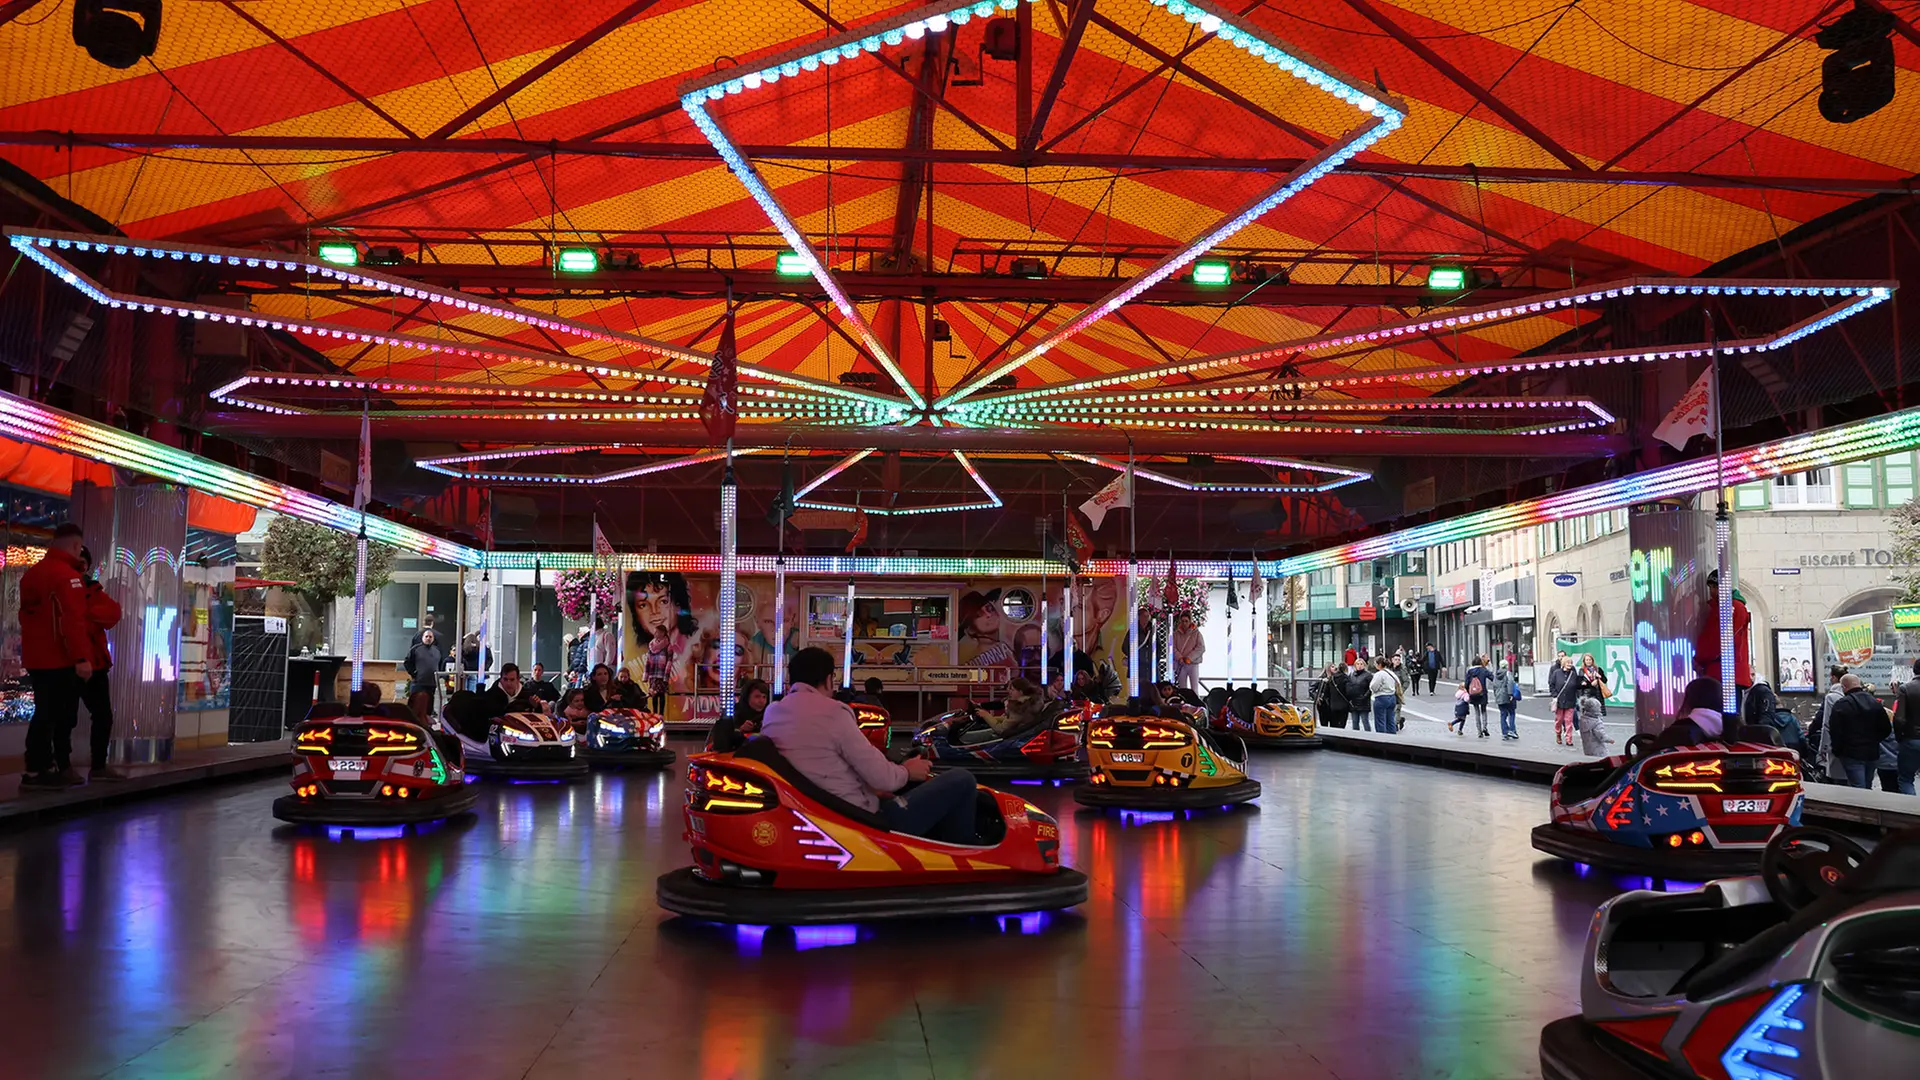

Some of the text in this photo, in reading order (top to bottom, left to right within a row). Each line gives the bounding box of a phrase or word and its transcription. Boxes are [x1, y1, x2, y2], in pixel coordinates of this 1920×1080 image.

[1800, 551, 1856, 566] EISCAFÉ
[1829, 625, 1872, 652] Mandeln
[1121, 753, 1134, 762] 08
[340, 761, 356, 770] 22
[1737, 800, 1755, 812] 23
[1037, 824, 1056, 838] FIRE
